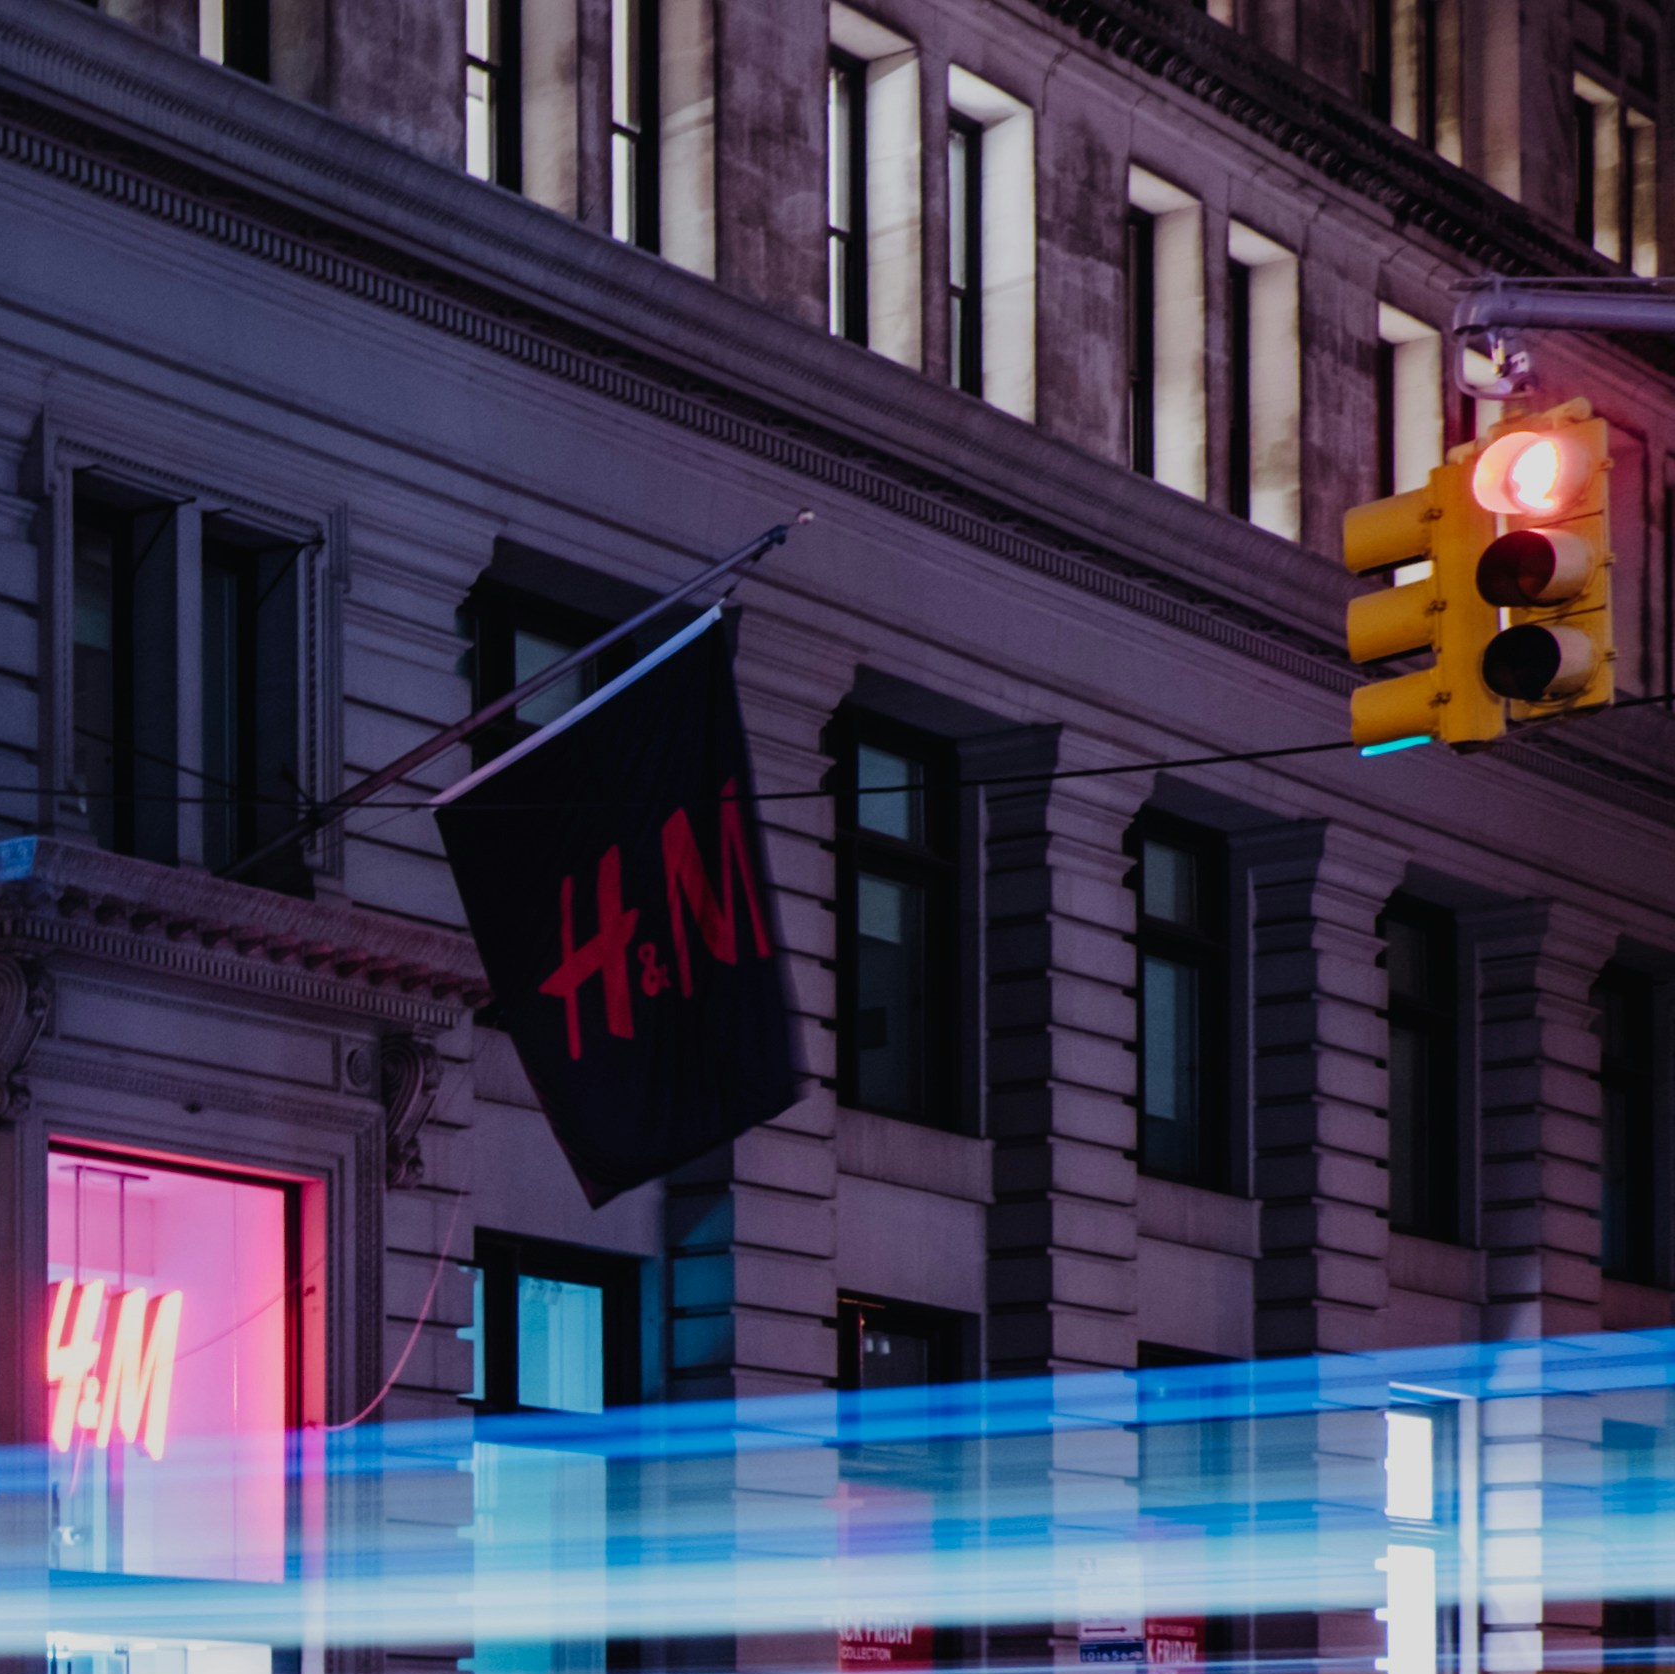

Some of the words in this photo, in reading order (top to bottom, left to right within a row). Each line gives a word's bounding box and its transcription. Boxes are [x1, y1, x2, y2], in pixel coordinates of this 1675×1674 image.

[538, 777, 771, 1060] H&M
[47, 1278, 183, 1461] H&M
[865, 1617, 913, 1644] FRIDAY
[841, 1646, 892, 1661] COLLECTION
[1157, 1640, 1198, 1664] FRIDAY
